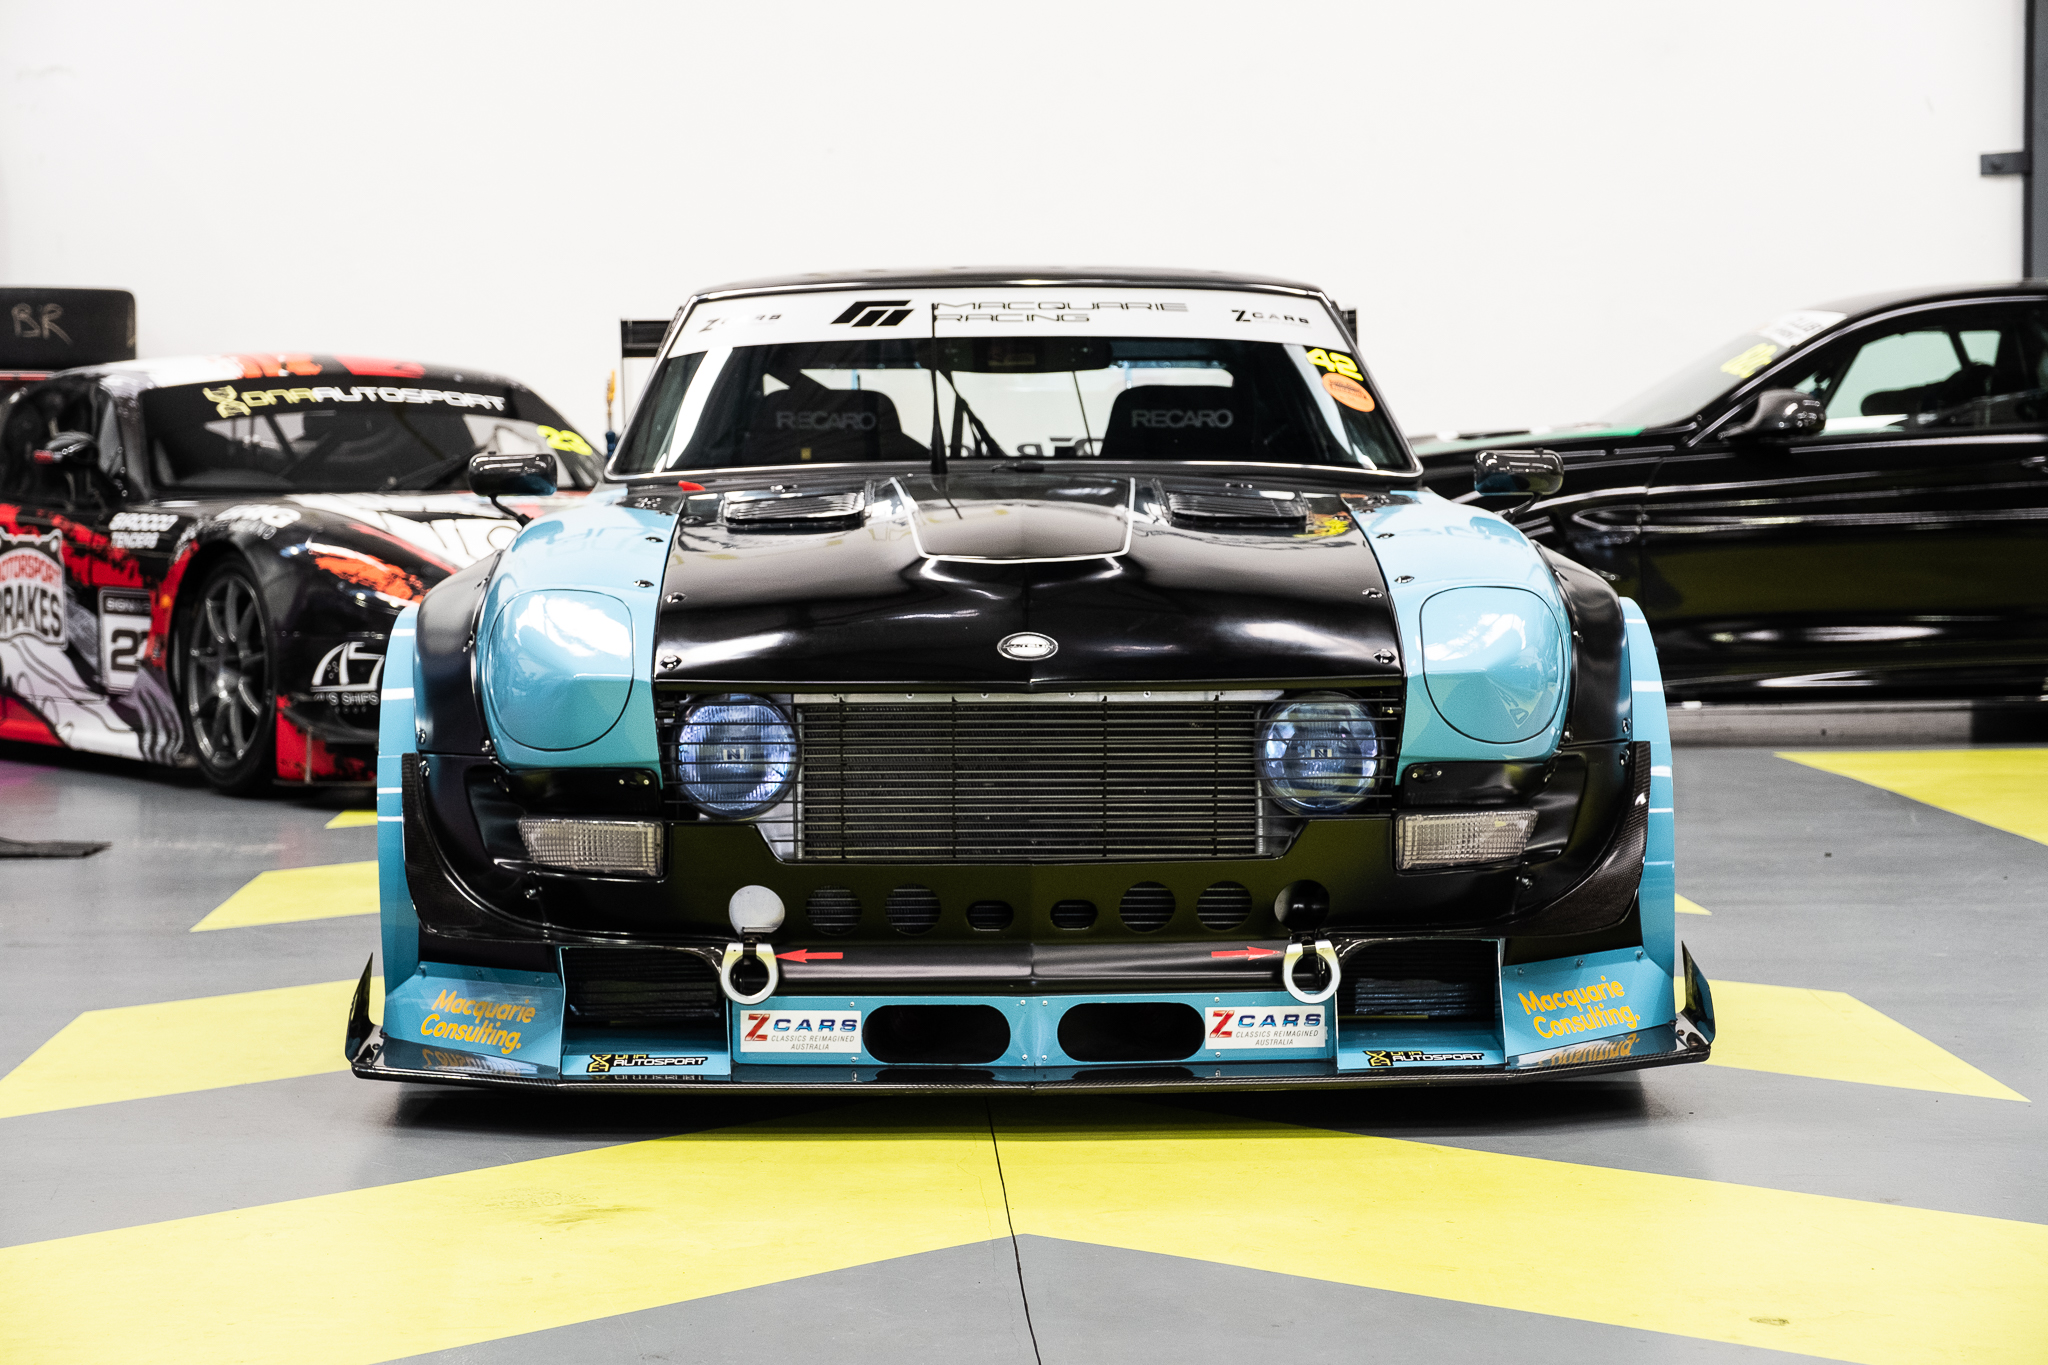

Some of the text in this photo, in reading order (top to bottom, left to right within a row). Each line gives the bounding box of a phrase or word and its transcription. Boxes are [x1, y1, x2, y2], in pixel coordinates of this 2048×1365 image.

[934, 302, 1188, 312] MACQUARIE
[934, 314, 1090, 322] RACING
[1306, 348, 1364, 381] 42
[776, 411, 876, 430] RECARO
[1131, 410, 1234, 429] RECARO
[0, 585, 61, 637] RAKES
[431, 989, 536, 1024] Macquarie
[1518, 975, 1625, 1015] Macquarie
[421, 1013, 522, 1054] Consulting.
[744, 1014, 858, 1041] Z CARS
[1209, 1010, 1321, 1038] Z CARS
[1533, 1003, 1640, 1039] Consulting.
[613, 1057, 706, 1067] AUTOSPORT
[1392, 1053, 1483, 1062] AUTOSPORT
